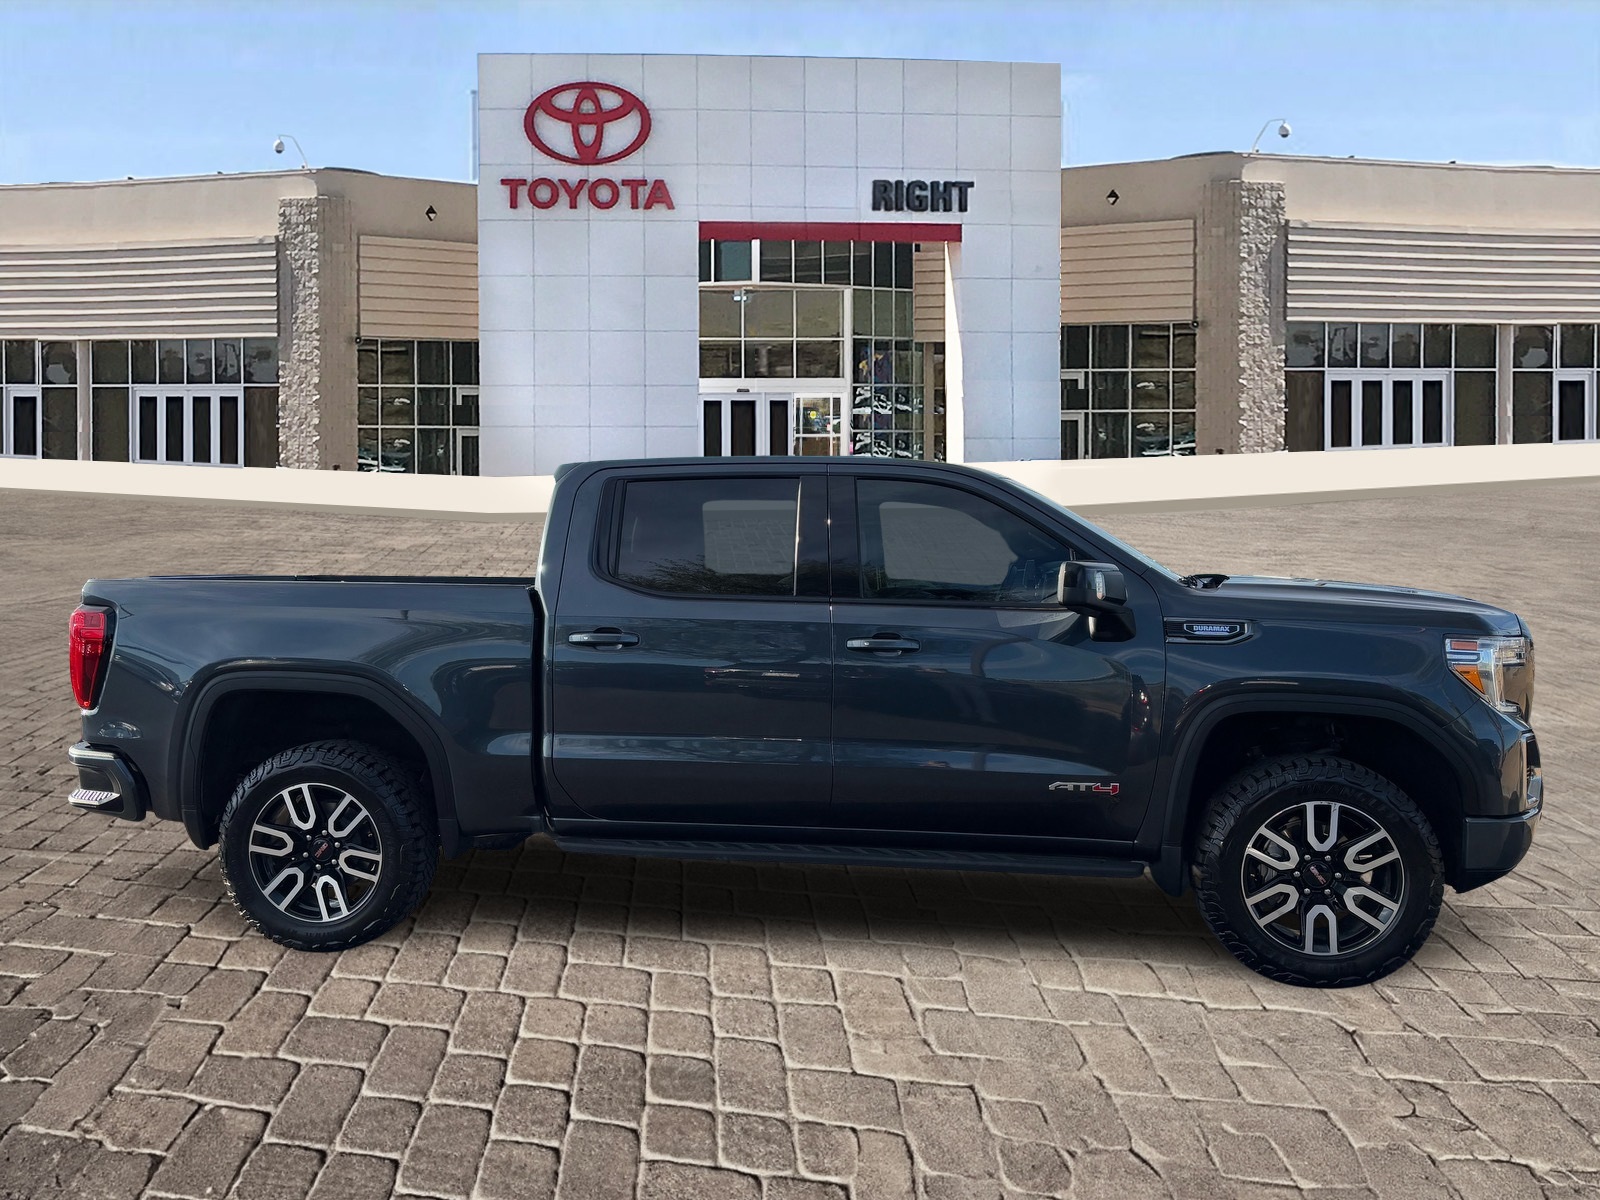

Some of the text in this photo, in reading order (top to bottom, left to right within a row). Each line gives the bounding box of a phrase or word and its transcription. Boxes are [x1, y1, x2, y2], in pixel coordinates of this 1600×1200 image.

[500, 177, 675, 210] TOYOTA
[872, 179, 975, 212] RIGHT
[1048, 781, 1120, 796] AT4
